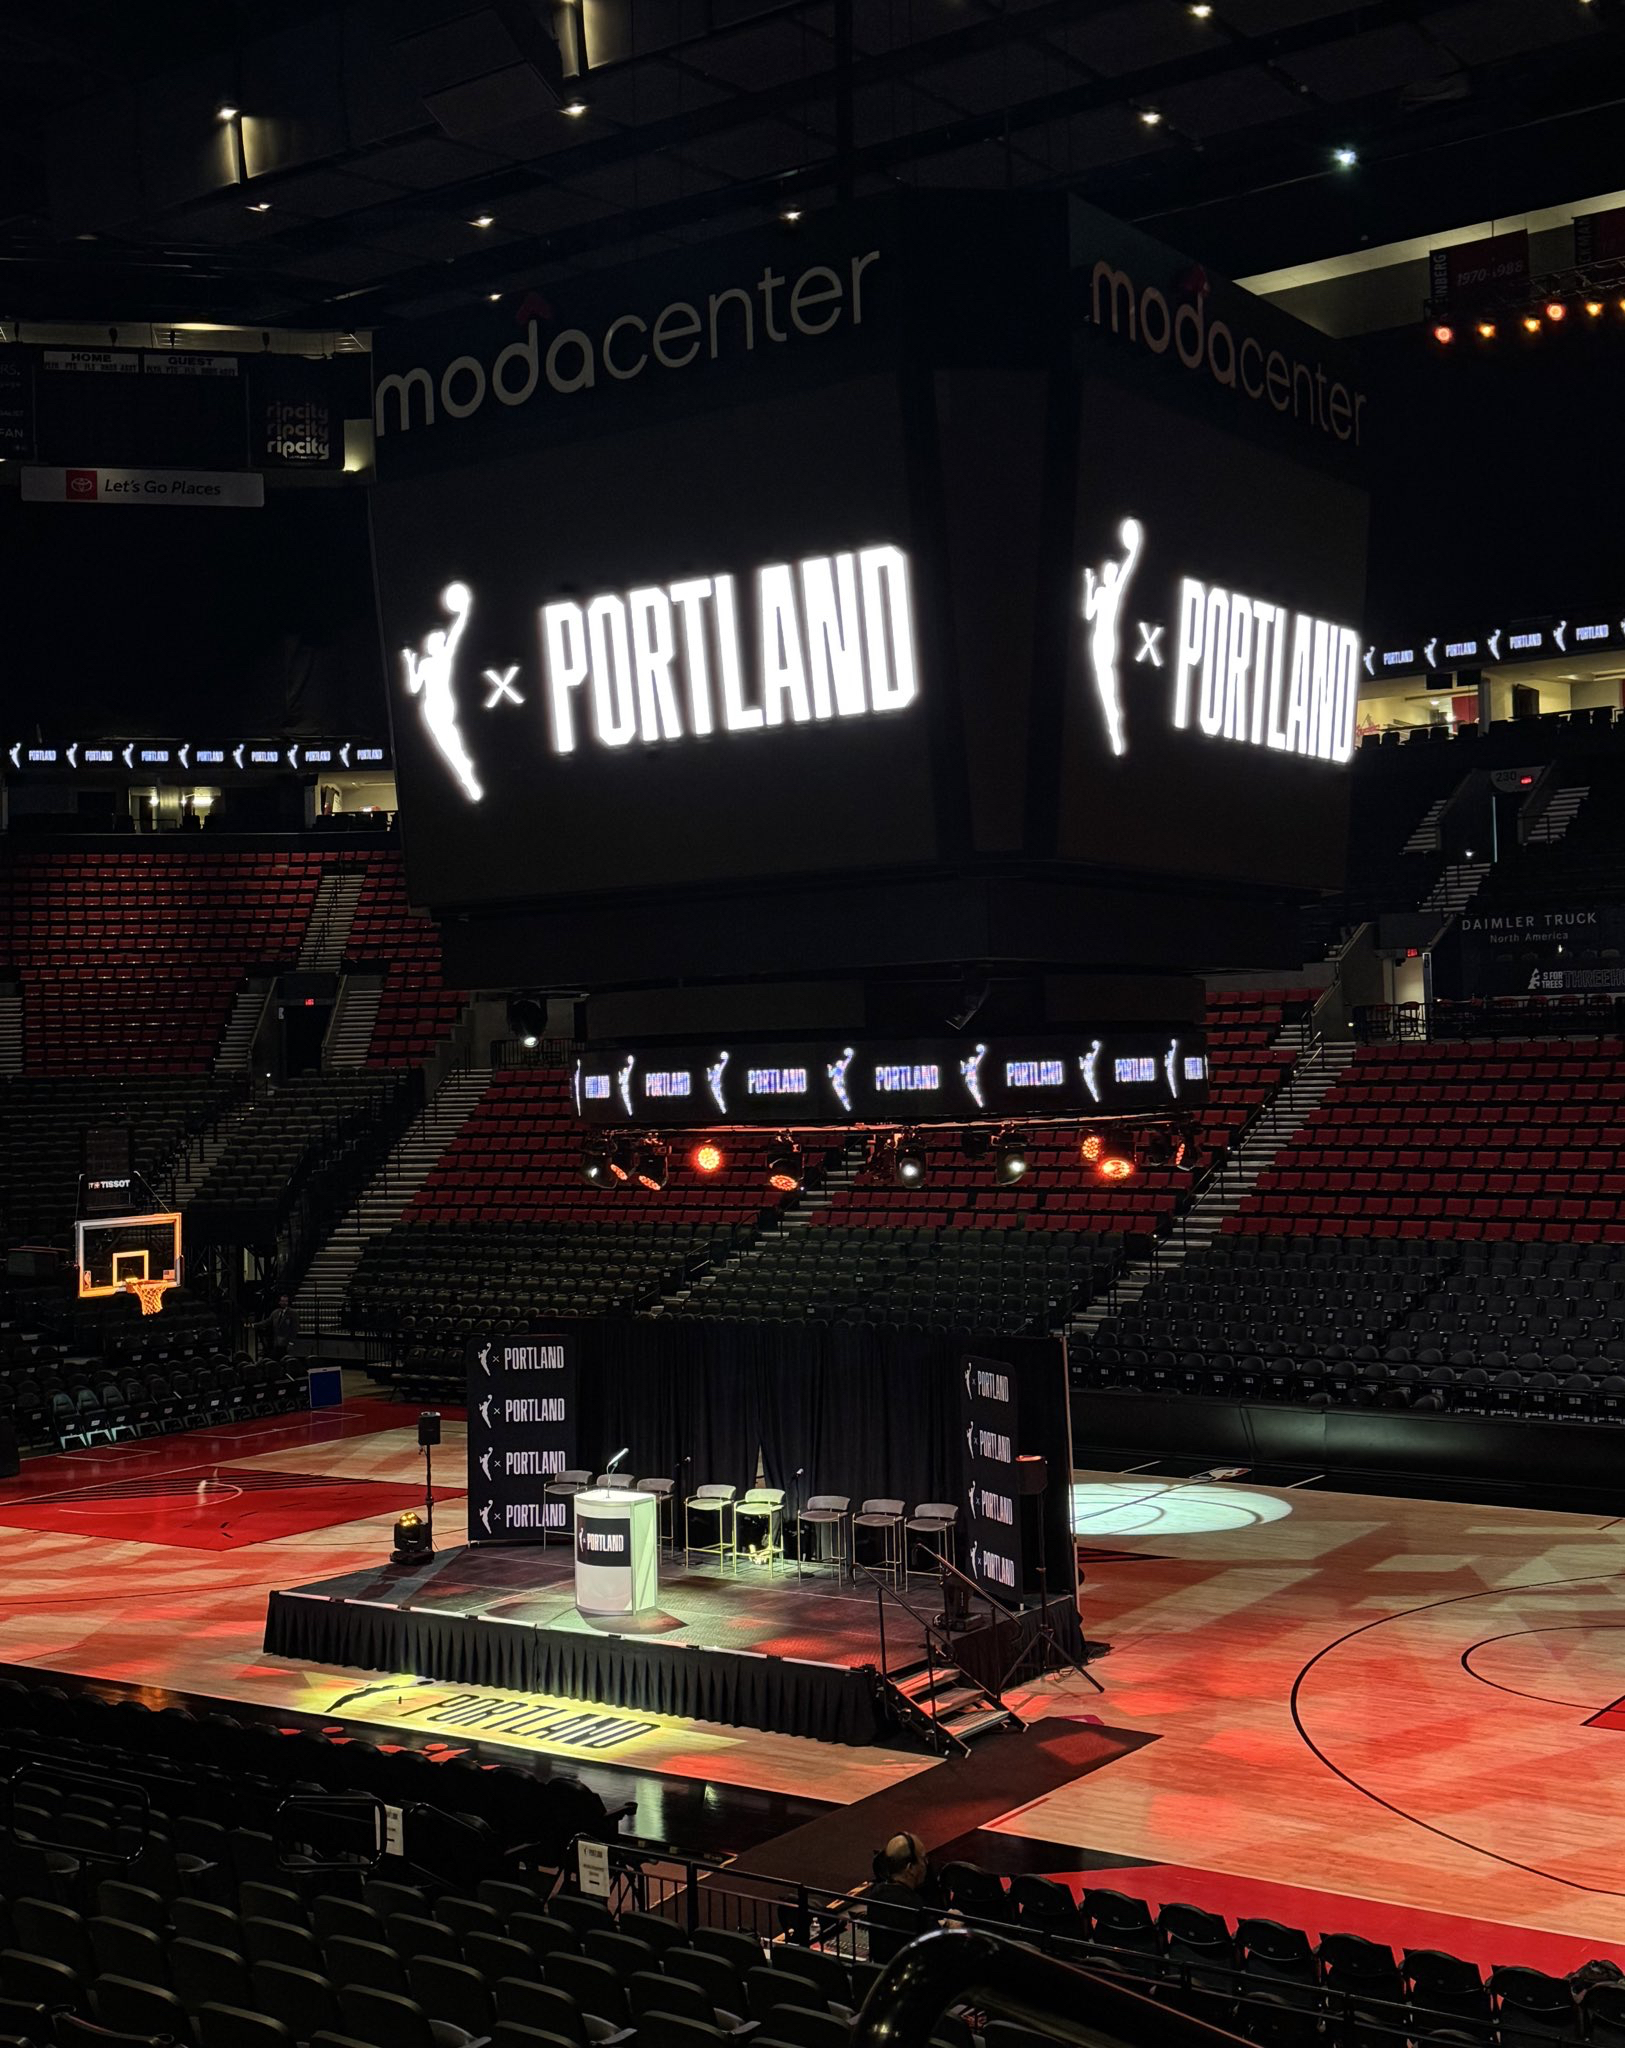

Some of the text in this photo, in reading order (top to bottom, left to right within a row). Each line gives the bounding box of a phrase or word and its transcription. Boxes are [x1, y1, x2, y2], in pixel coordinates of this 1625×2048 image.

[71, 353, 112, 363] HOME
[168, 356, 214, 366] GUEST
[266, 401, 328, 424] ripcity
[266, 419, 328, 442] ripcity
[267, 436, 329, 460] ripcity
[144, 480, 168, 493] Go
[171, 481, 221, 495] Places
[543, 544, 918, 754] PORTLAND
[1173, 576, 1361, 764] PORTLAND
[1461, 912, 1598, 931] DAIMLER TRUCK
[1489, 932, 1568, 944] North America
[1541, 980, 1563, 988] TREES
[1549, 971, 1563, 980] FOR
[748, 1068, 808, 1094] PORTLAND
[876, 1064, 940, 1092] PORTLAND
[1006, 1060, 1064, 1087] PORTLAND
[1115, 1057, 1156, 1083] PORTLAND
[645, 1071, 691, 1097] PORTLAND
[101, 1180, 130, 1189] TISSOT
[504, 1346, 565, 1370] PORTLAND
[977, 1370, 1009, 1402] PORTLAND
[505, 1398, 565, 1422] PORTLAND
[979, 1429, 1011, 1464] PORTLAND
[506, 1451, 566, 1475] PORTLAND
[506, 1503, 566, 1528] PORTLAND
[981, 1489, 1013, 1526] PORTLAND
[587, 1533, 624, 1552] PORTLAND
[983, 1550, 1015, 1588] PORTLAND
[398, 1693, 661, 1749] PORTLAND
